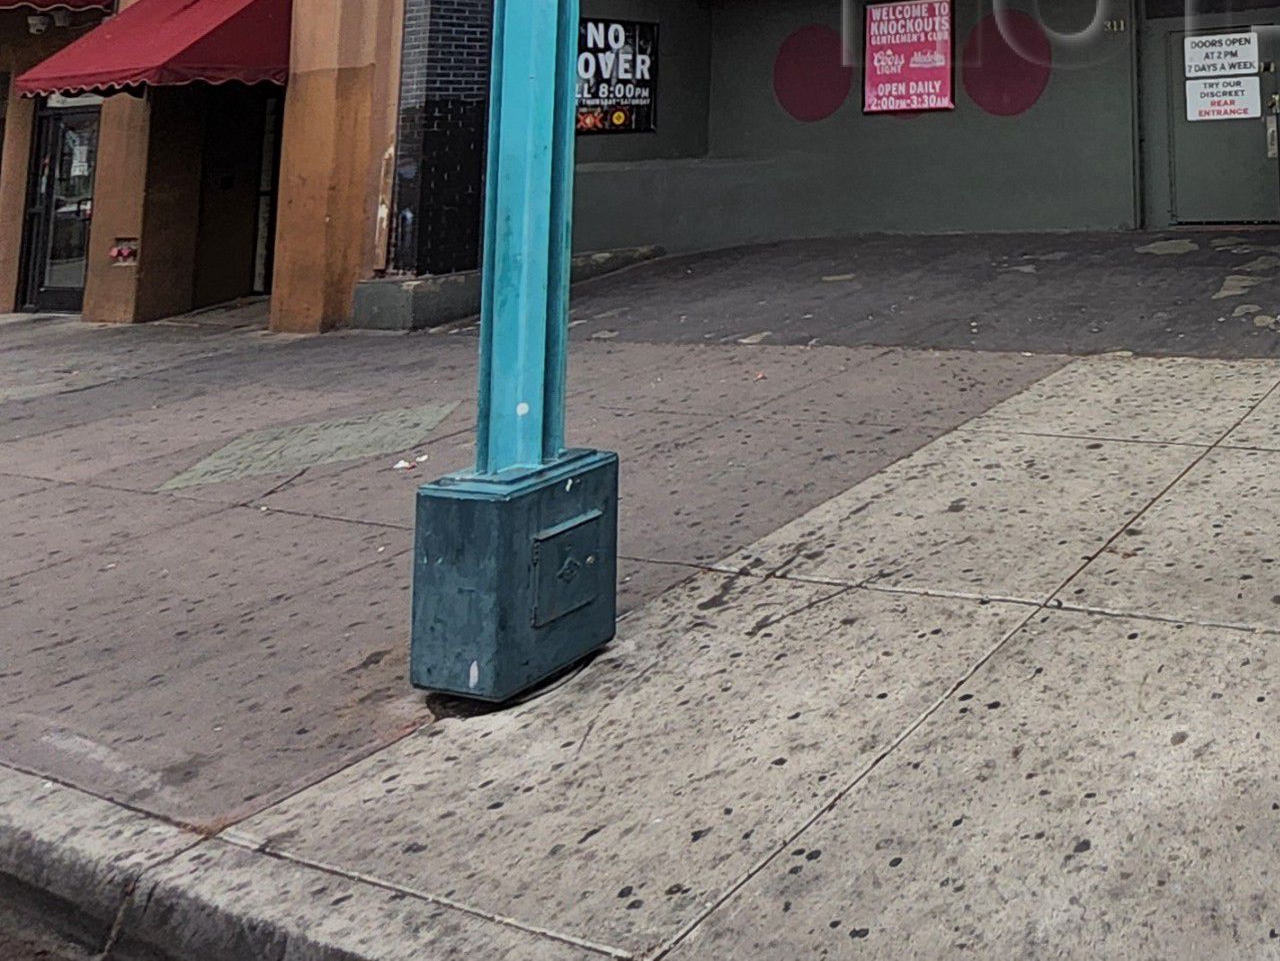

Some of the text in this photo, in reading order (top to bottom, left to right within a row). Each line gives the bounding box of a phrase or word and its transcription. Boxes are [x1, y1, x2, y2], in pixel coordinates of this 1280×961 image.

[872, 2, 949, 20] WELCOME TO
[871, 17, 950, 36] KNOCKOUTS
[587, 22, 625, 49] NO
[871, 33, 925, 45] GENTLEMEN'S
[1190, 37, 1251, 49] DOORS OPEN
[1203, 50, 1239, 60] AT 2 PM
[578, 52, 650, 79] OVER
[1187, 61, 1256, 73] 7 DAYS A WEEK
[878, 80, 941, 95] OPEN DAILY
[1222, 80, 1242, 88] OUR
[598, 83, 650, 98] 8:00PM
[1199, 89, 1246, 98] DISCREET
[1210, 99, 1236, 107] REAR
[1198, 108, 1249, 117] ENTRANCE
